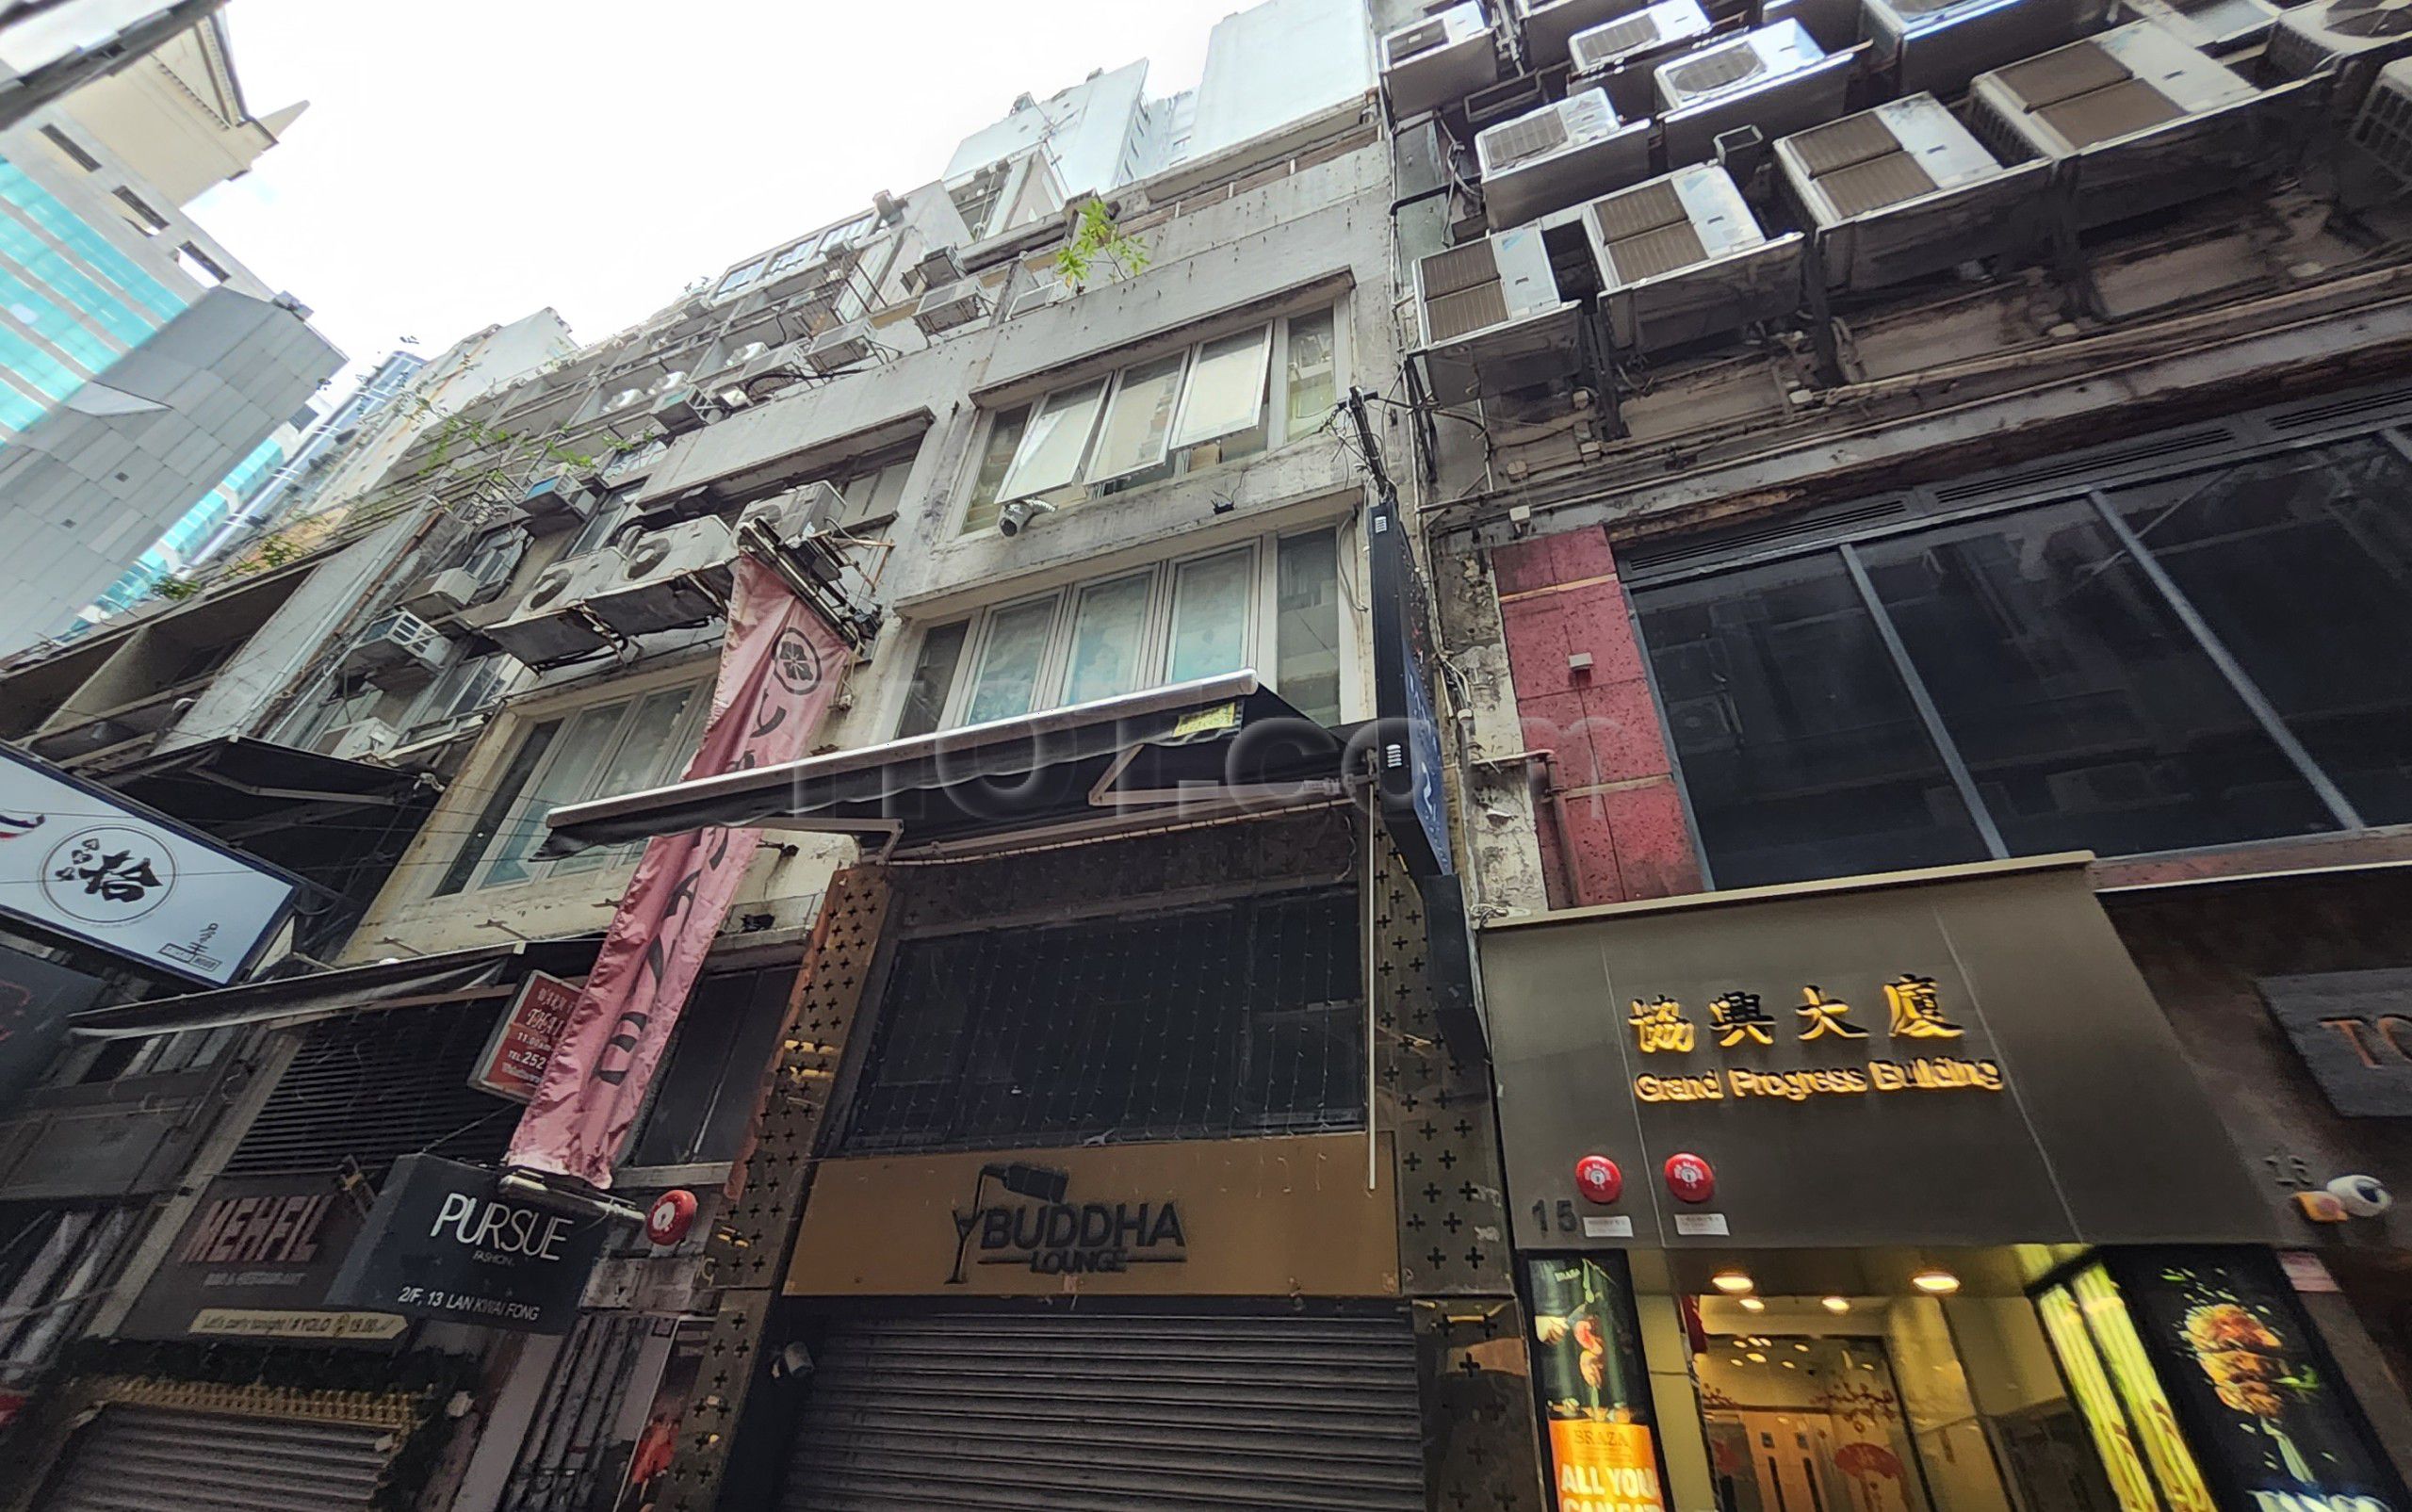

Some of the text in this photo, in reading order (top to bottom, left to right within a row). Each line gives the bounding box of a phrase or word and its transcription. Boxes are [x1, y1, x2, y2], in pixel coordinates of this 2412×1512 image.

[1634, 1056, 2004, 1101] Grand Progress Building
[179, 1195, 335, 1262] MEHFIL
[431, 1193, 574, 1260] PURSUE
[980, 1200, 1186, 1249] BUDDHA
[1532, 1198, 1576, 1233] 15
[1030, 1248, 1129, 1275] LOUNGE
[427, 1291, 444, 1308] 13
[446, 1293, 472, 1310] LAN
[472, 1297, 506, 1316] KWAI
[505, 1303, 540, 1321] FONG
[1560, 1463, 1660, 1499] ALL YOU
